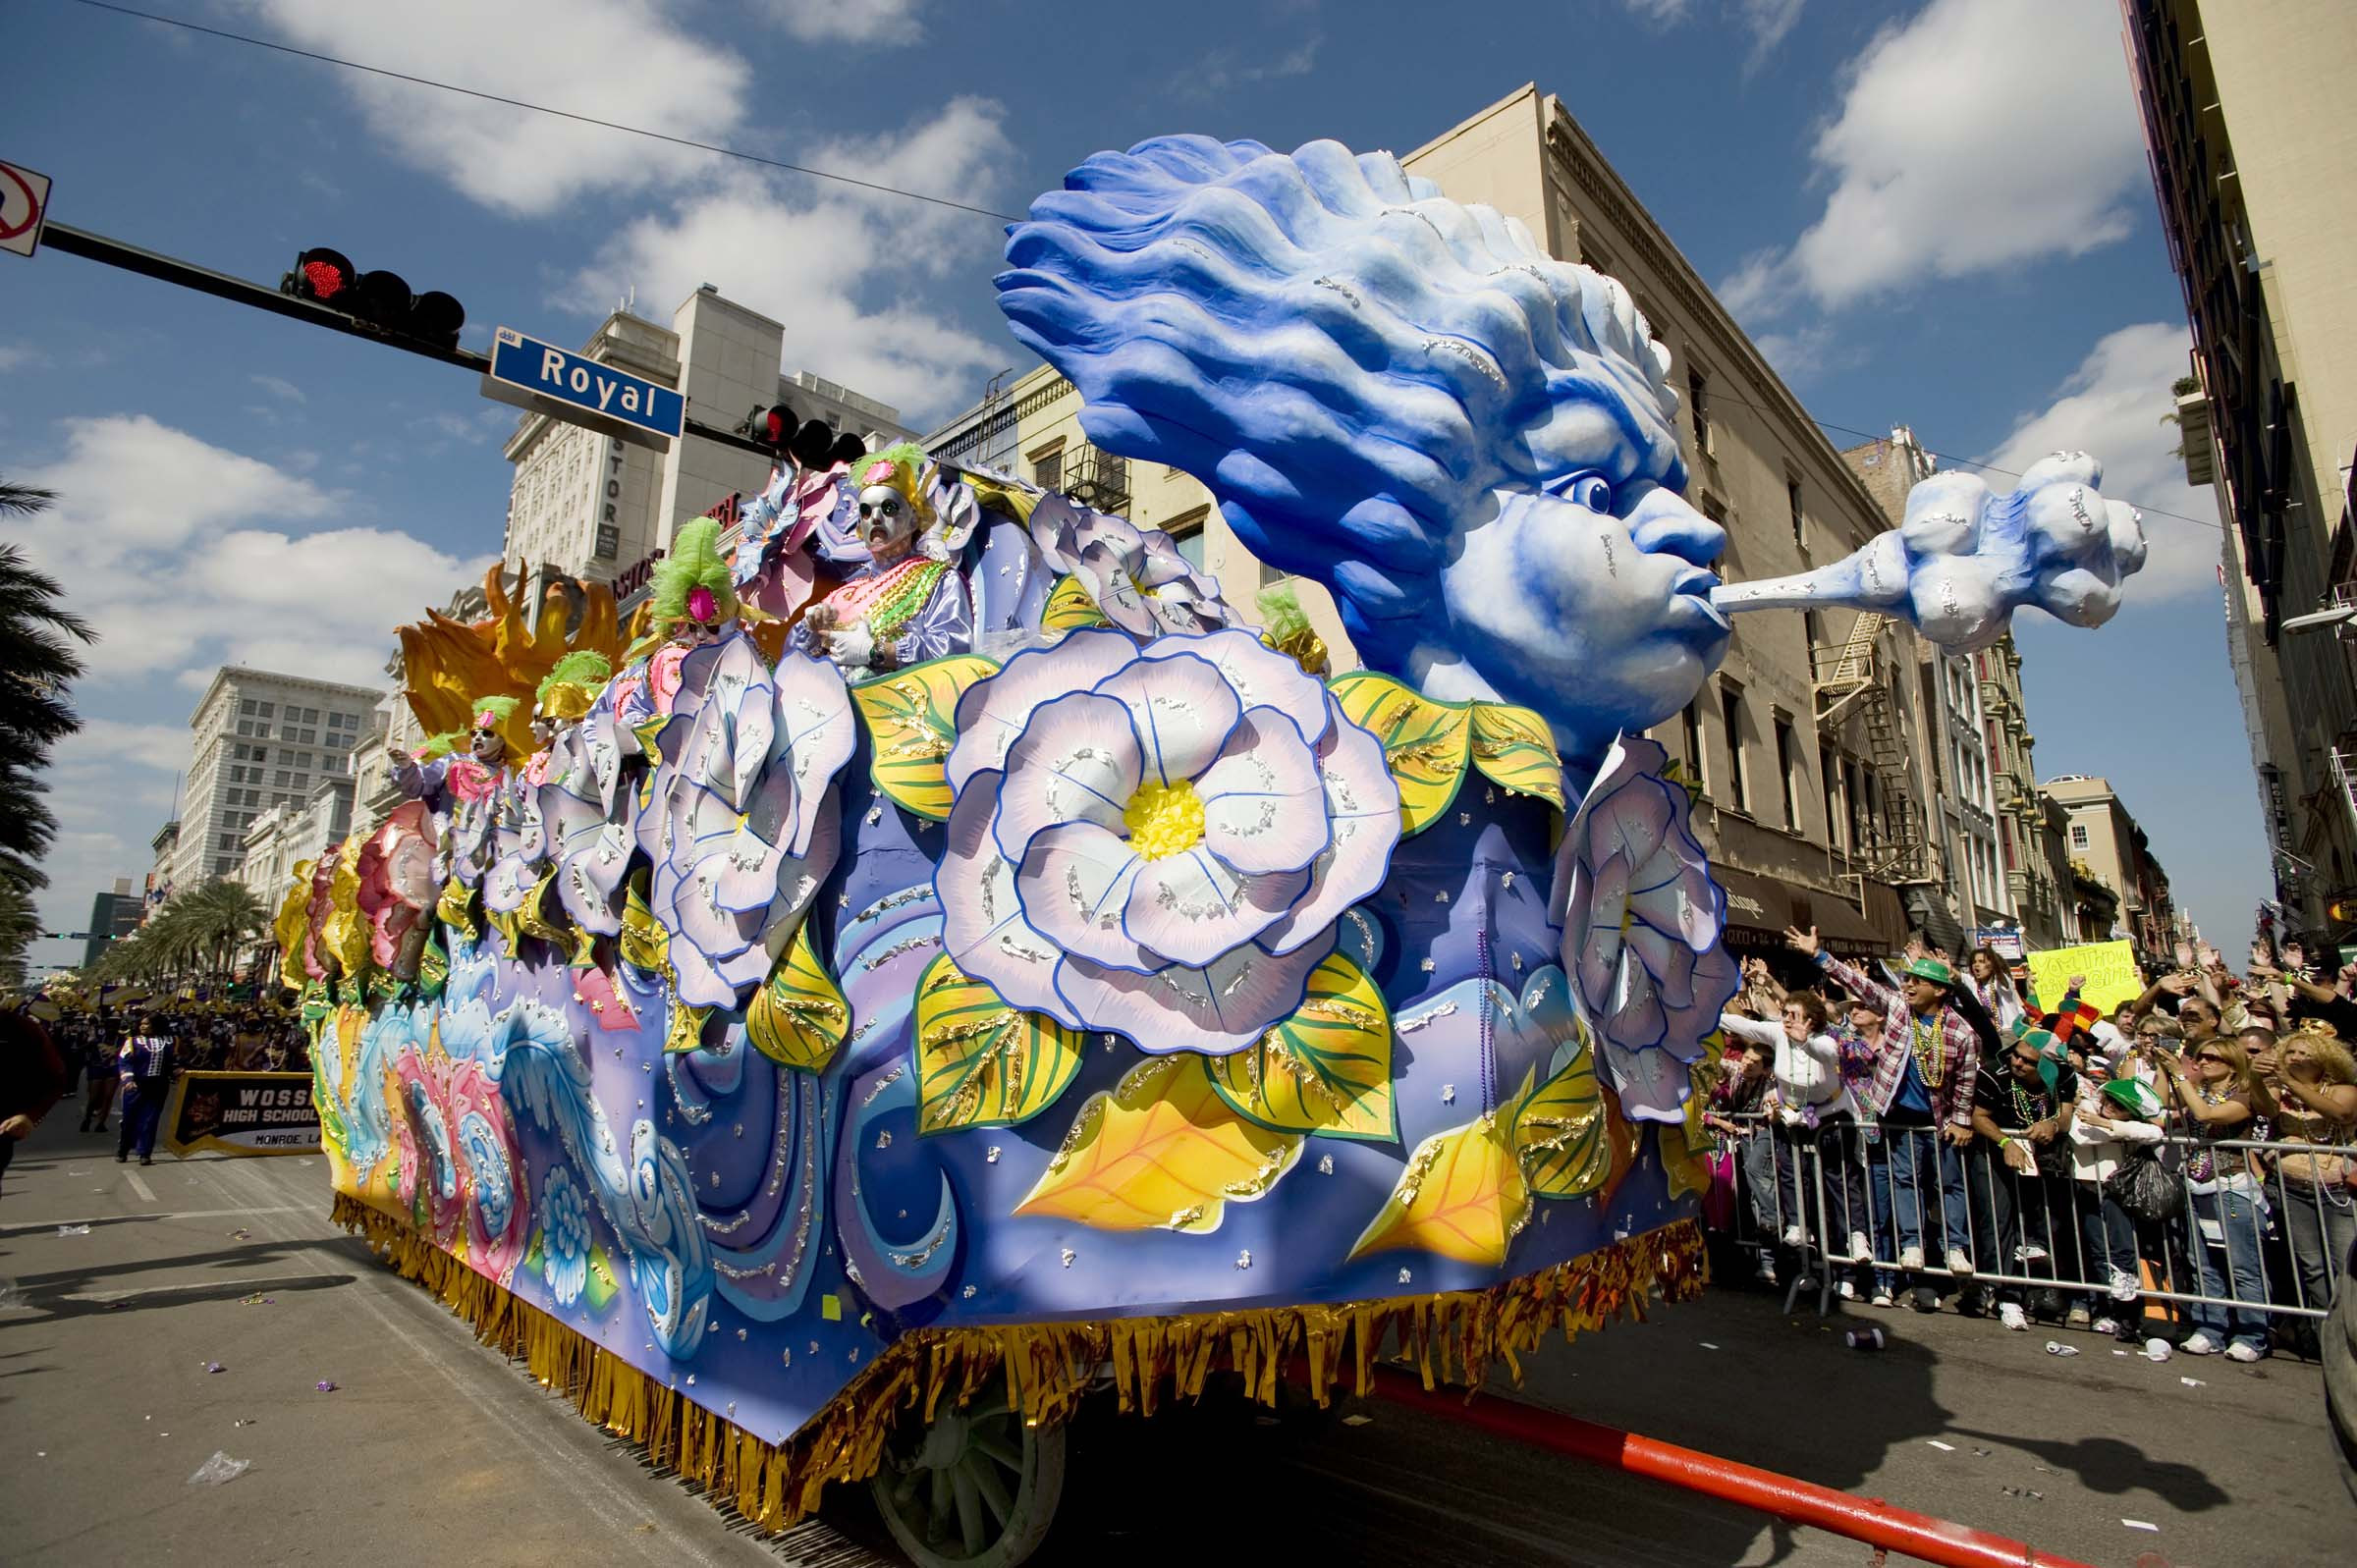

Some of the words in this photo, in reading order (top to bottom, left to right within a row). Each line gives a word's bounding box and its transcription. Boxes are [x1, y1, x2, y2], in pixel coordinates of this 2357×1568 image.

[540, 349, 656, 417] Royal
[222, 1109, 258, 1122] HIGH
[262, 1108, 318, 1122] SCHOOL
